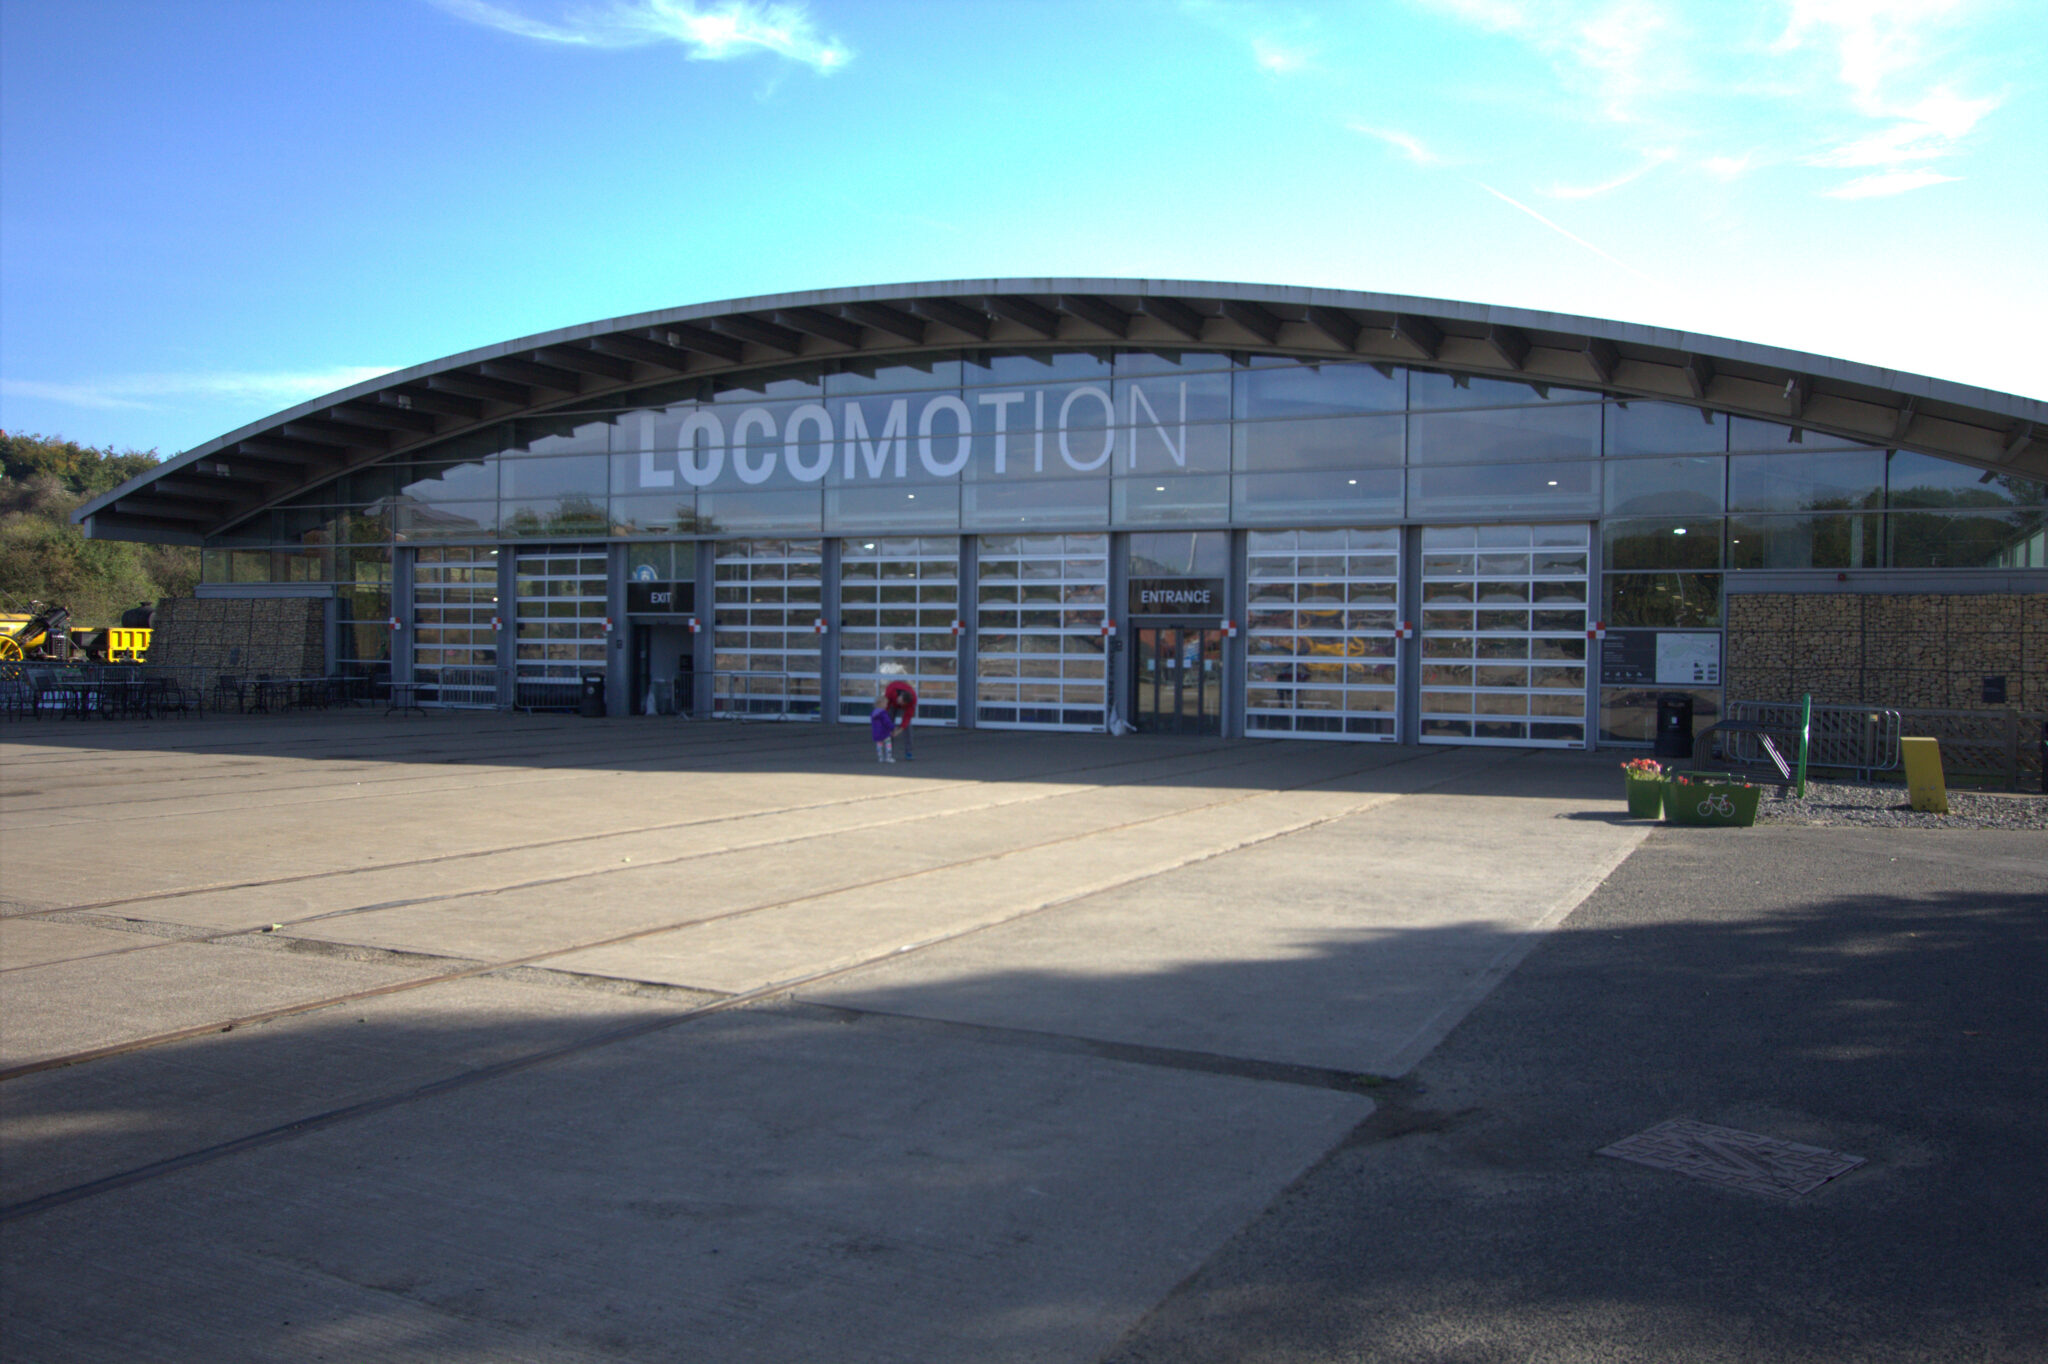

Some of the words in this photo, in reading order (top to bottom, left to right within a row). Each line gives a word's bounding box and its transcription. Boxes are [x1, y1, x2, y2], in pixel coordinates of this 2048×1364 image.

[638, 381, 1187, 487] LOCOMOTION
[650, 592, 672, 604] EXIT
[1141, 590, 1211, 604] ENTRANCE
